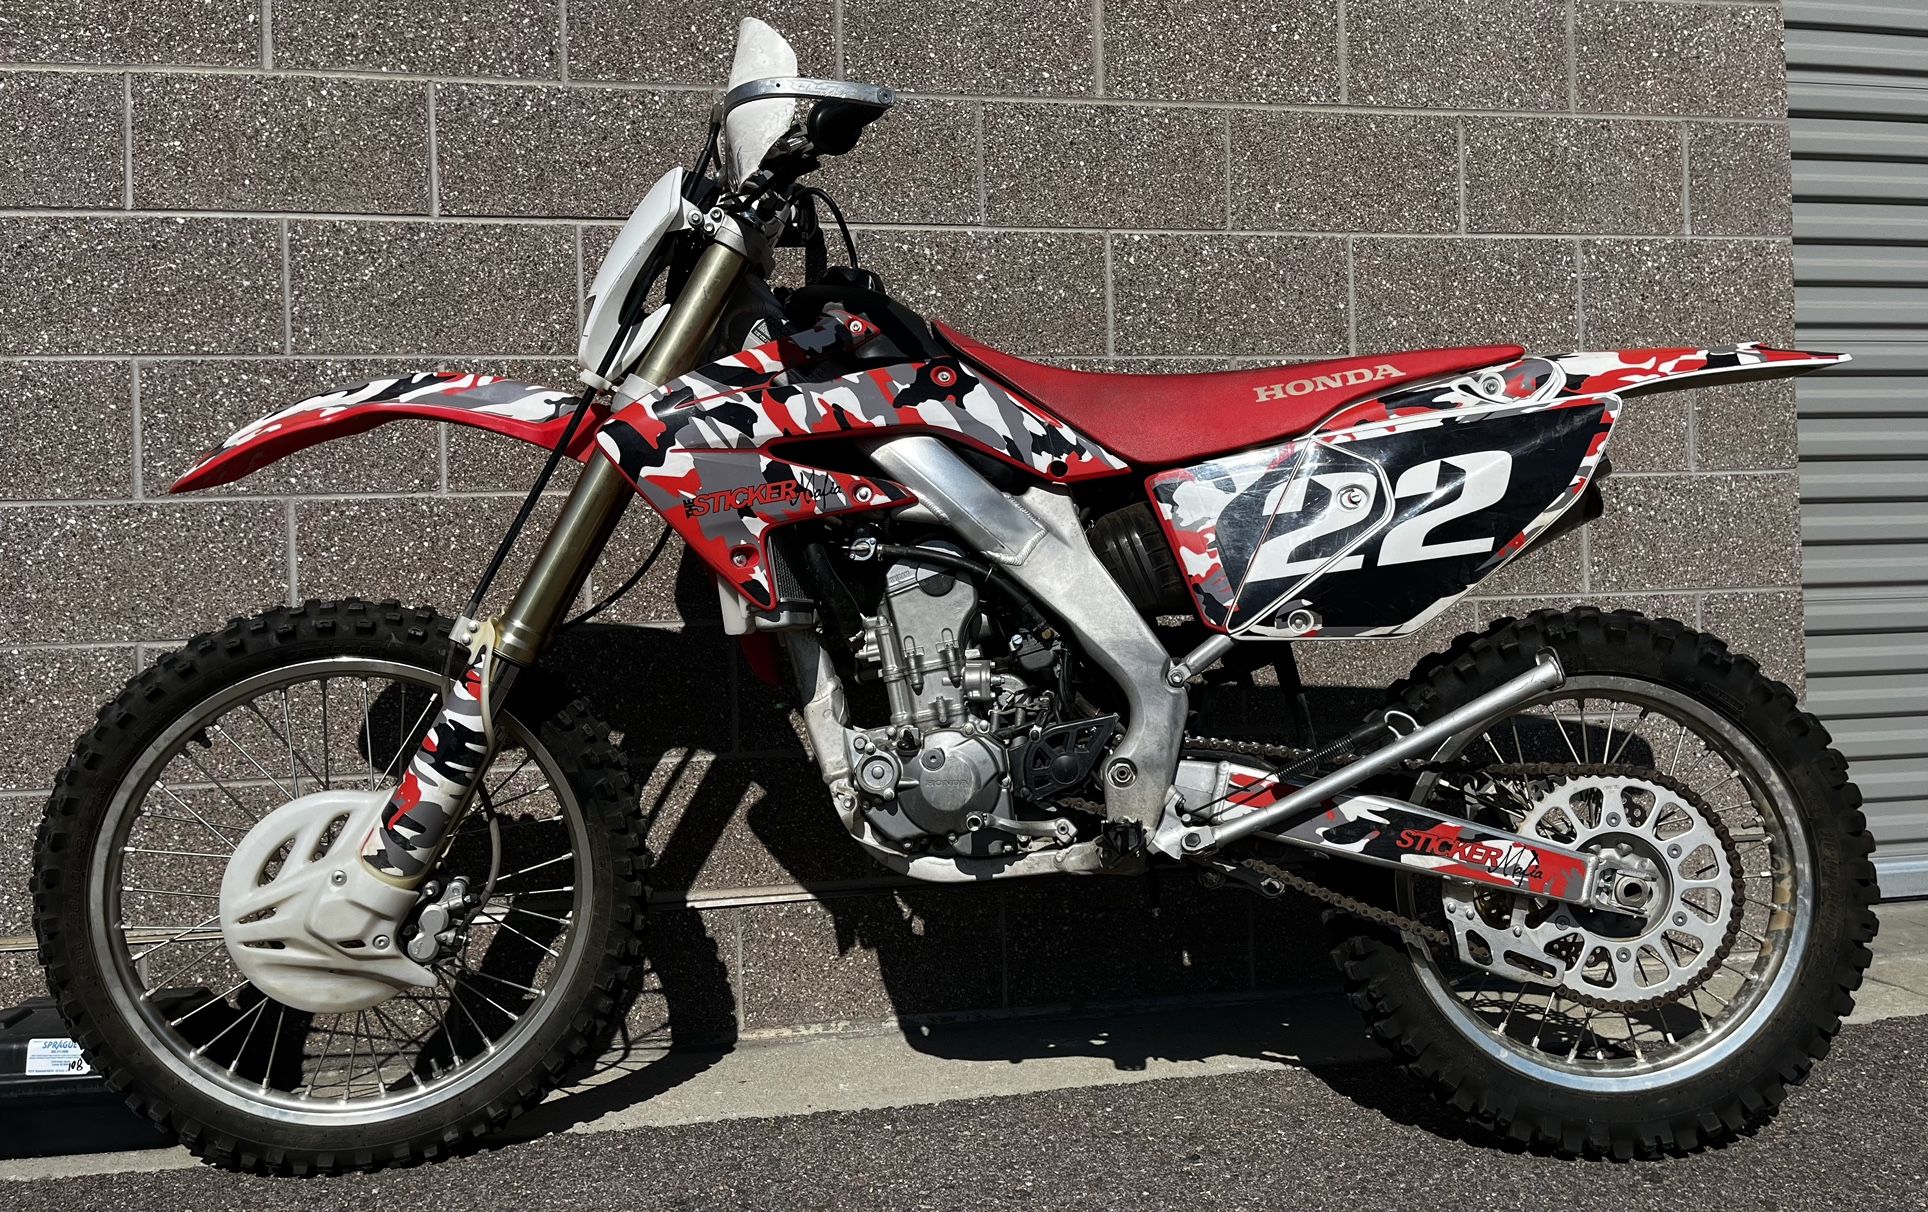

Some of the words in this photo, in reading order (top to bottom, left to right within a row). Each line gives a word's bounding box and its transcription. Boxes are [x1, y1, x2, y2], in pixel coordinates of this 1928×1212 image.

[1253, 364, 1406, 403] HONDA
[693, 478, 798, 517] STICKER
[790, 469, 842, 510] Mafia
[1245, 450, 1512, 583] 22
[925, 779, 969, 788] HONDA
[1396, 828, 1503, 867] STICKER
[1488, 845, 1543, 888] Mafia
[42, 1040, 78, 1050] SPRAGUE
[68, 1057, 83, 1072] 108
